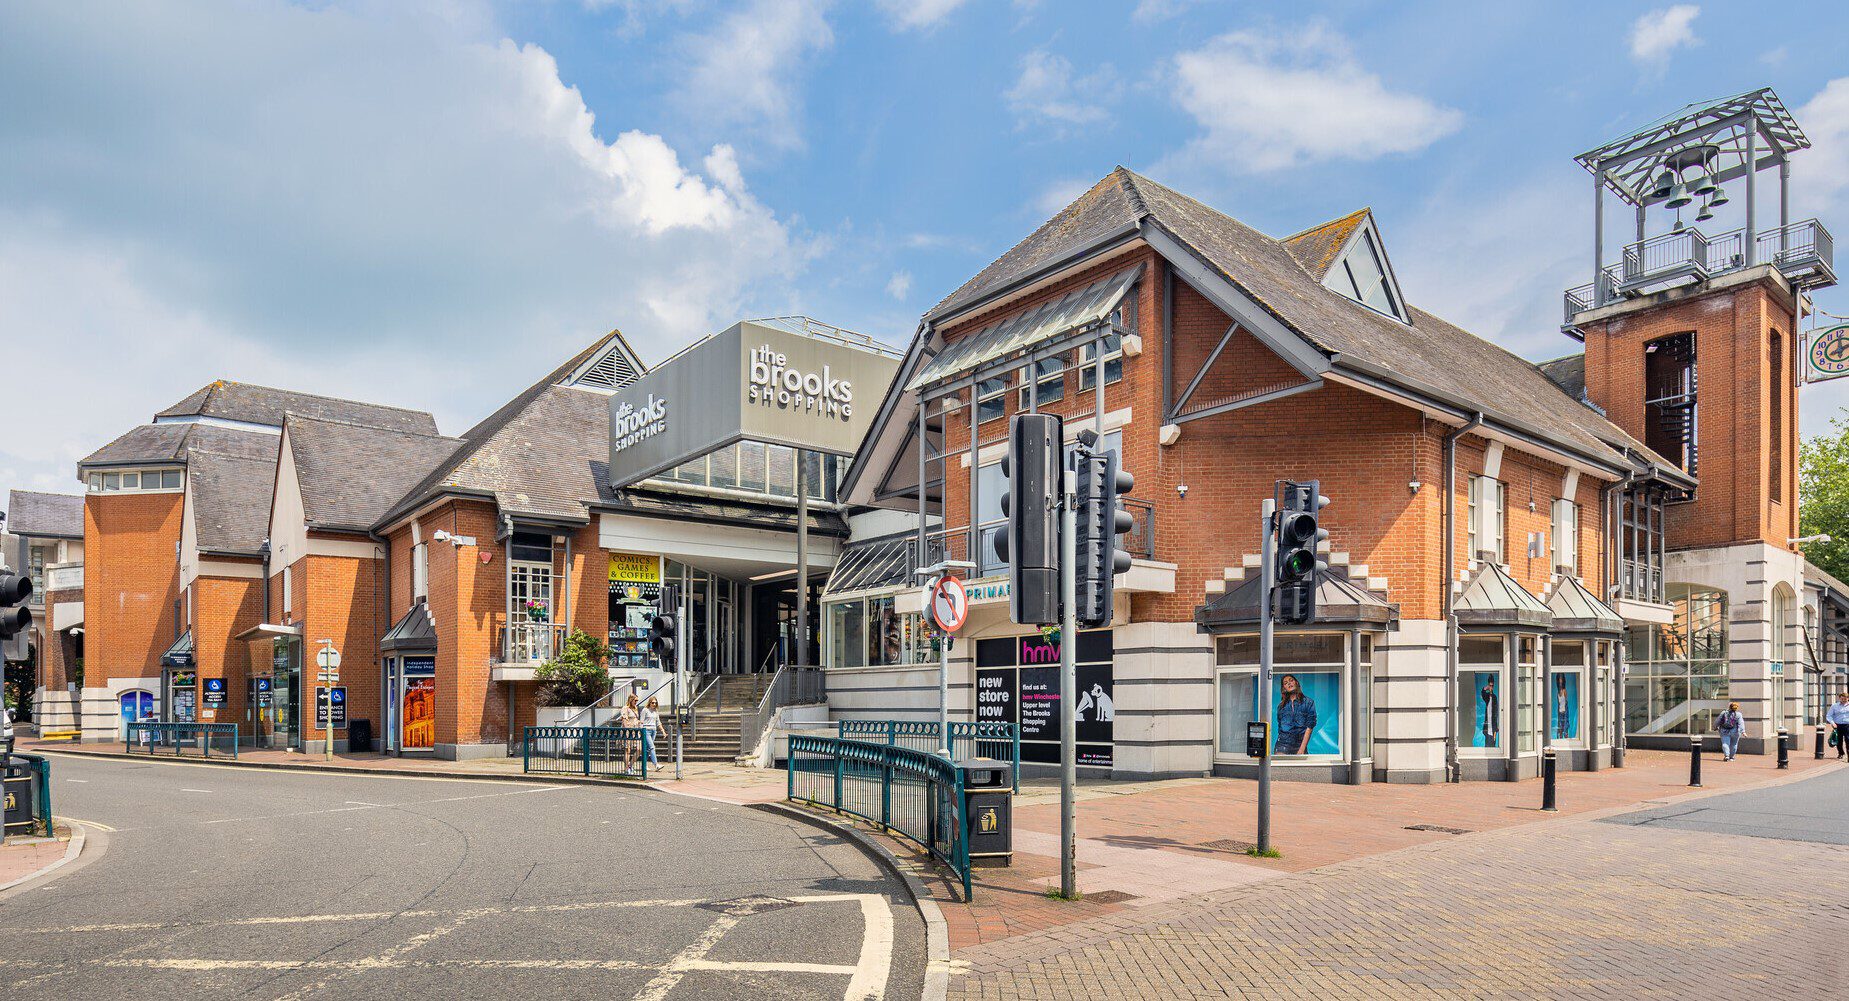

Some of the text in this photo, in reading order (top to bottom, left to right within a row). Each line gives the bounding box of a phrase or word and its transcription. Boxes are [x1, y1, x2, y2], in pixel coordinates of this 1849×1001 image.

[1836, 330, 1844, 338] 12
[756, 344, 787, 367] the
[1816, 350, 1822, 358] 9
[750, 348, 853, 402] brooks
[750, 384, 853, 418] SHOPPING
[615, 394, 666, 439] brooks
[615, 420, 666, 452] SHOPPING
[612, 555, 654, 565] COMICS,
[617, 563, 649, 572] GAMES
[620, 572, 655, 580] COFFEE
[966, 584, 1010, 601] PRIMA
[1023, 641, 1061, 663] hmv
[979, 677, 1003, 688] new
[979, 689, 1010, 702] store
[979, 706, 1004, 717] now
[1022, 702, 1038, 710] Upper
[1022, 718, 1046, 726] Shopping
